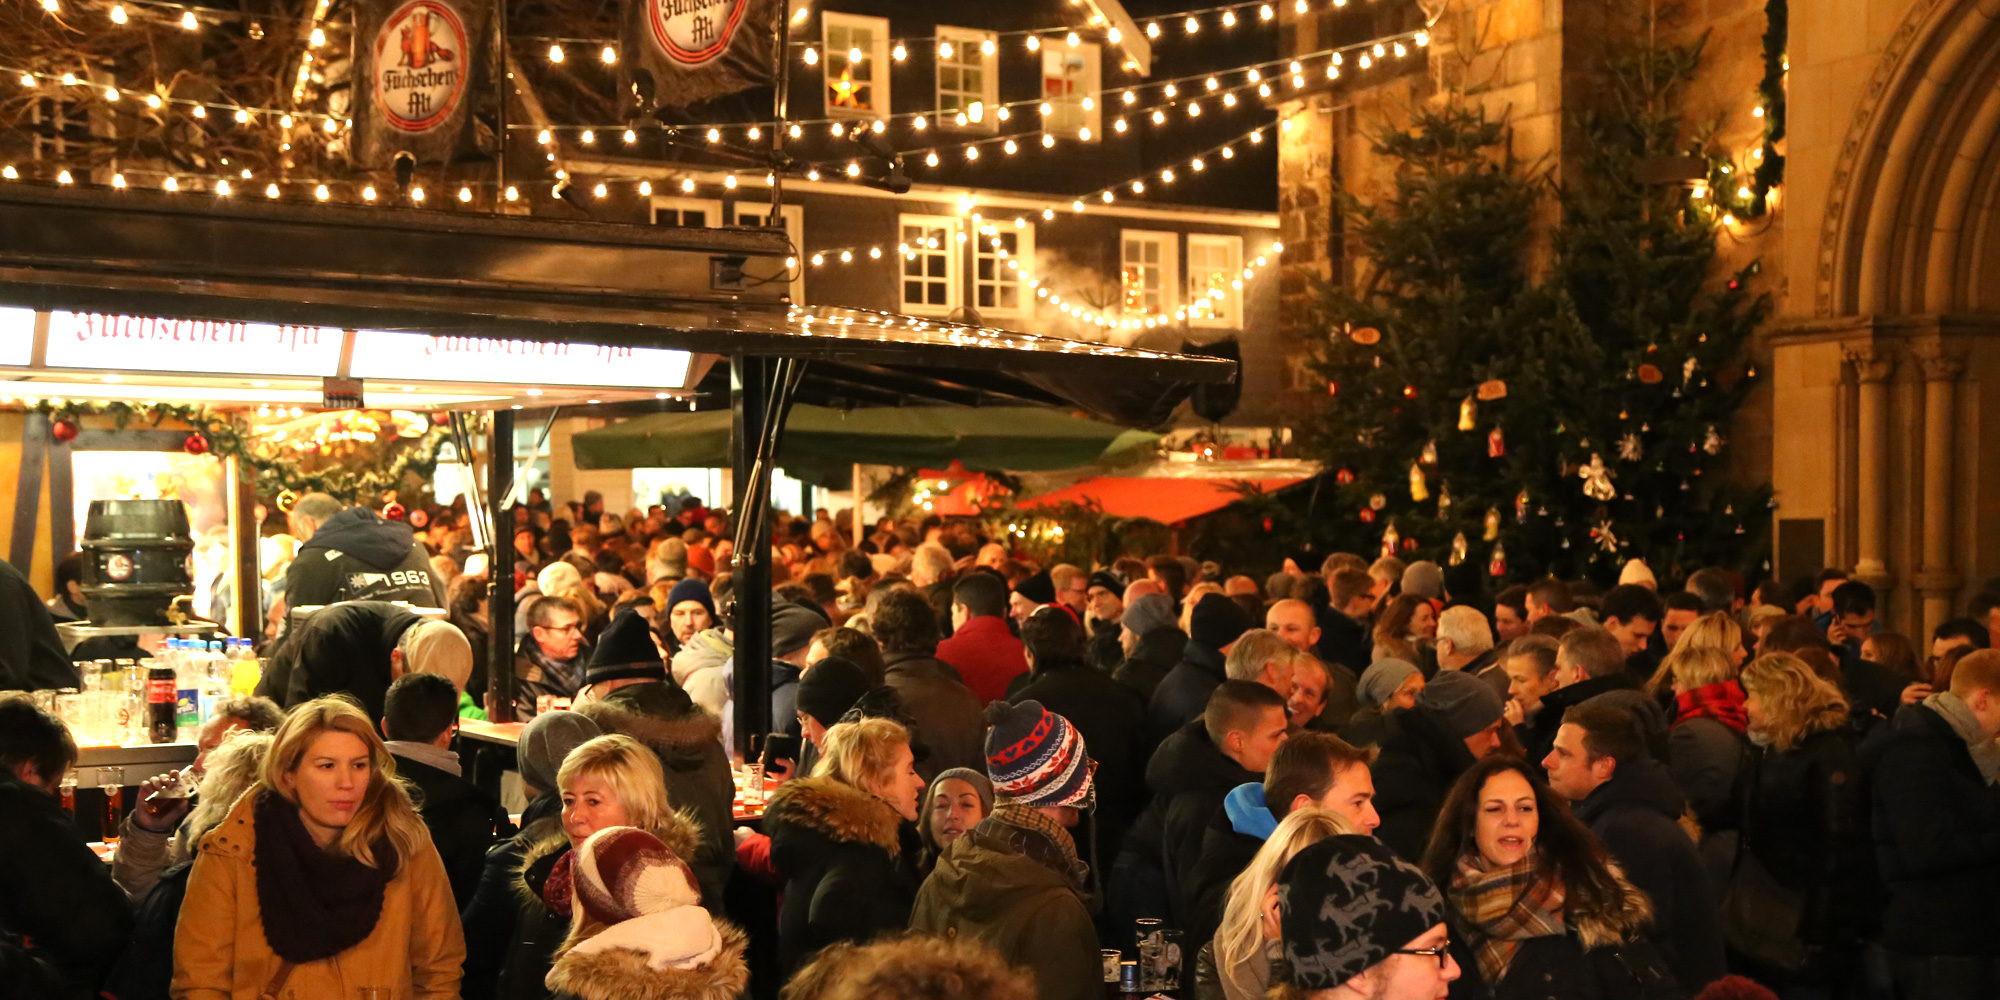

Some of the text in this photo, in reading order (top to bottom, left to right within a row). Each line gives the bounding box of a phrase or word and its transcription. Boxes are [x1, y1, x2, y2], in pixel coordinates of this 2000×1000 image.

[692, 15, 715, 44] Alt
[408, 91, 431, 118] Alt
[377, 570, 430, 587] 1963
